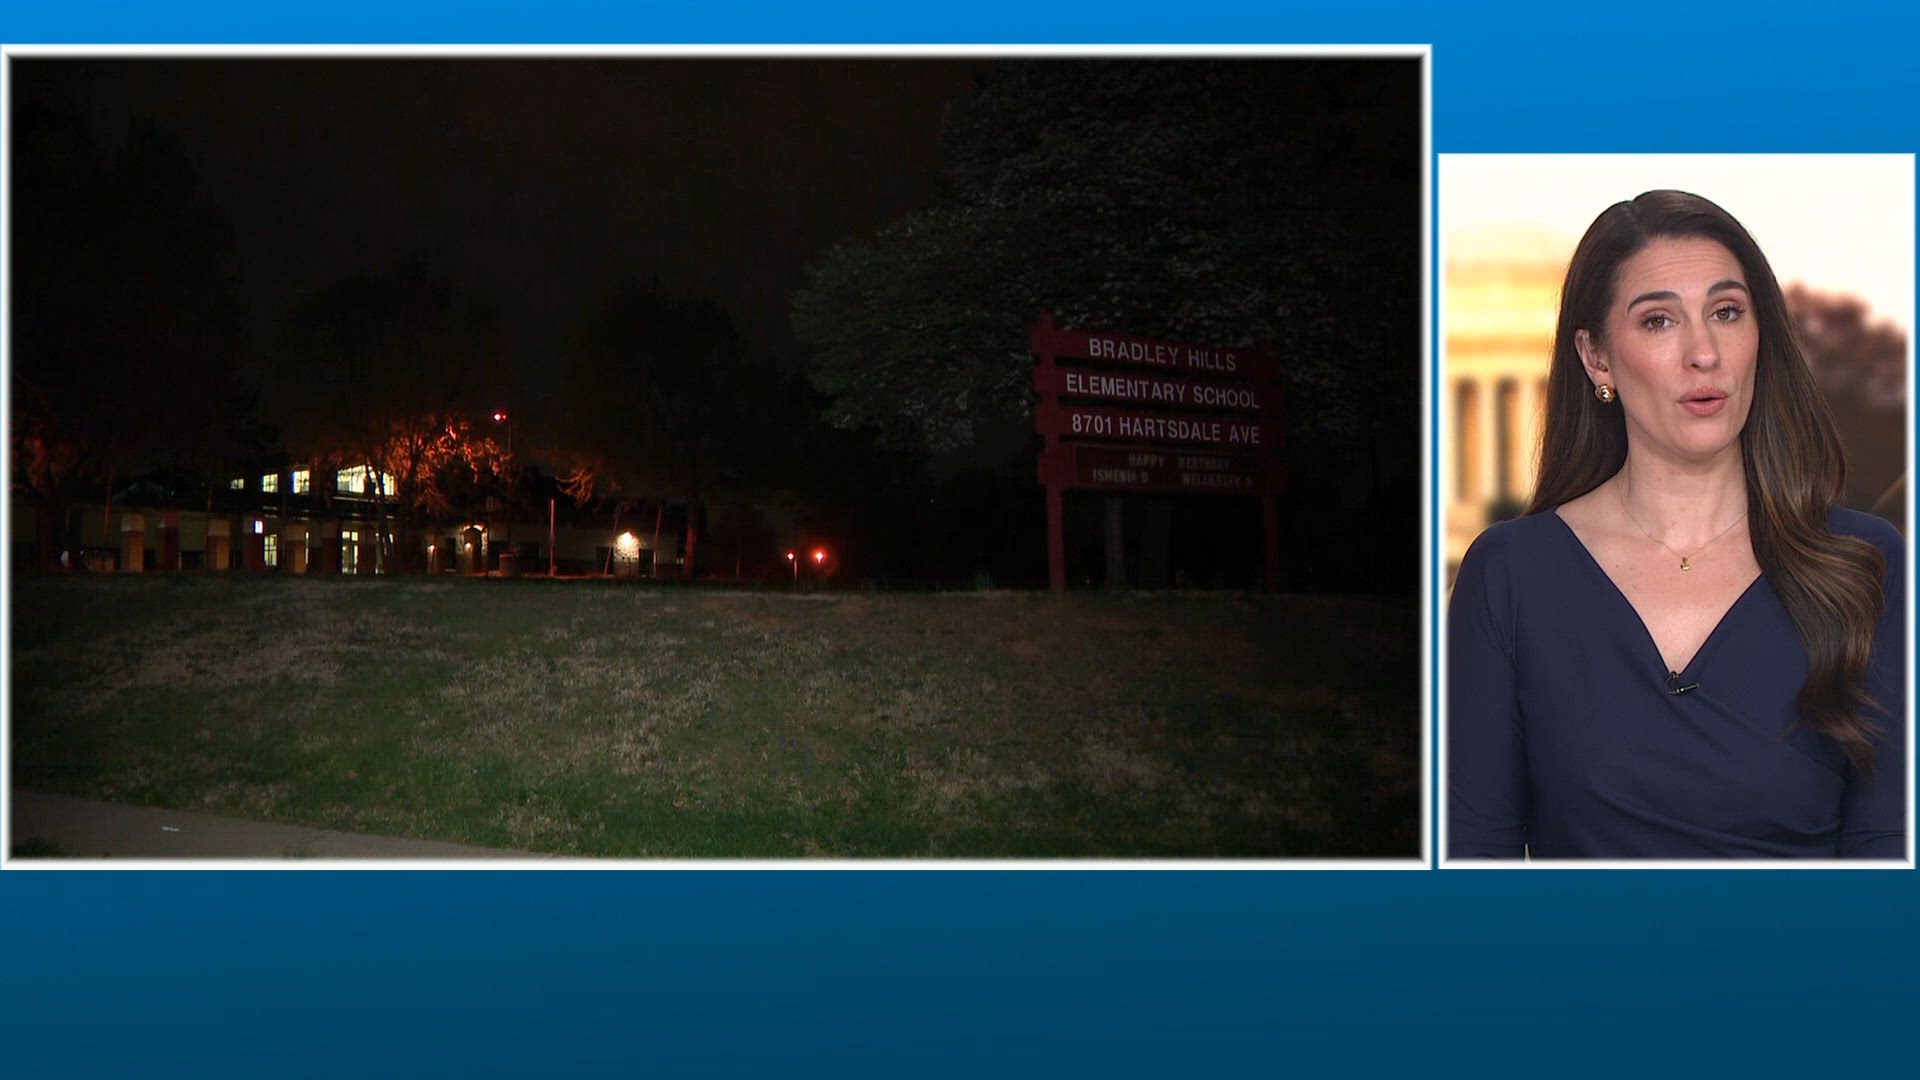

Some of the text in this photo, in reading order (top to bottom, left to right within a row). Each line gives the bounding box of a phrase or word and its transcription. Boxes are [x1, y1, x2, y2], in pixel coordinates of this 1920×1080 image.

[1089, 338, 1236, 371] BRADLEY HILLS
[1066, 373, 1260, 409] ELEMENTARY SCHOOL
[1072, 413, 1260, 444] 8701 HARTSDALE AVE
[1092, 468, 1137, 482] ISMENIA
[1128, 453, 1231, 471] HAPPY BIRTHDAY
